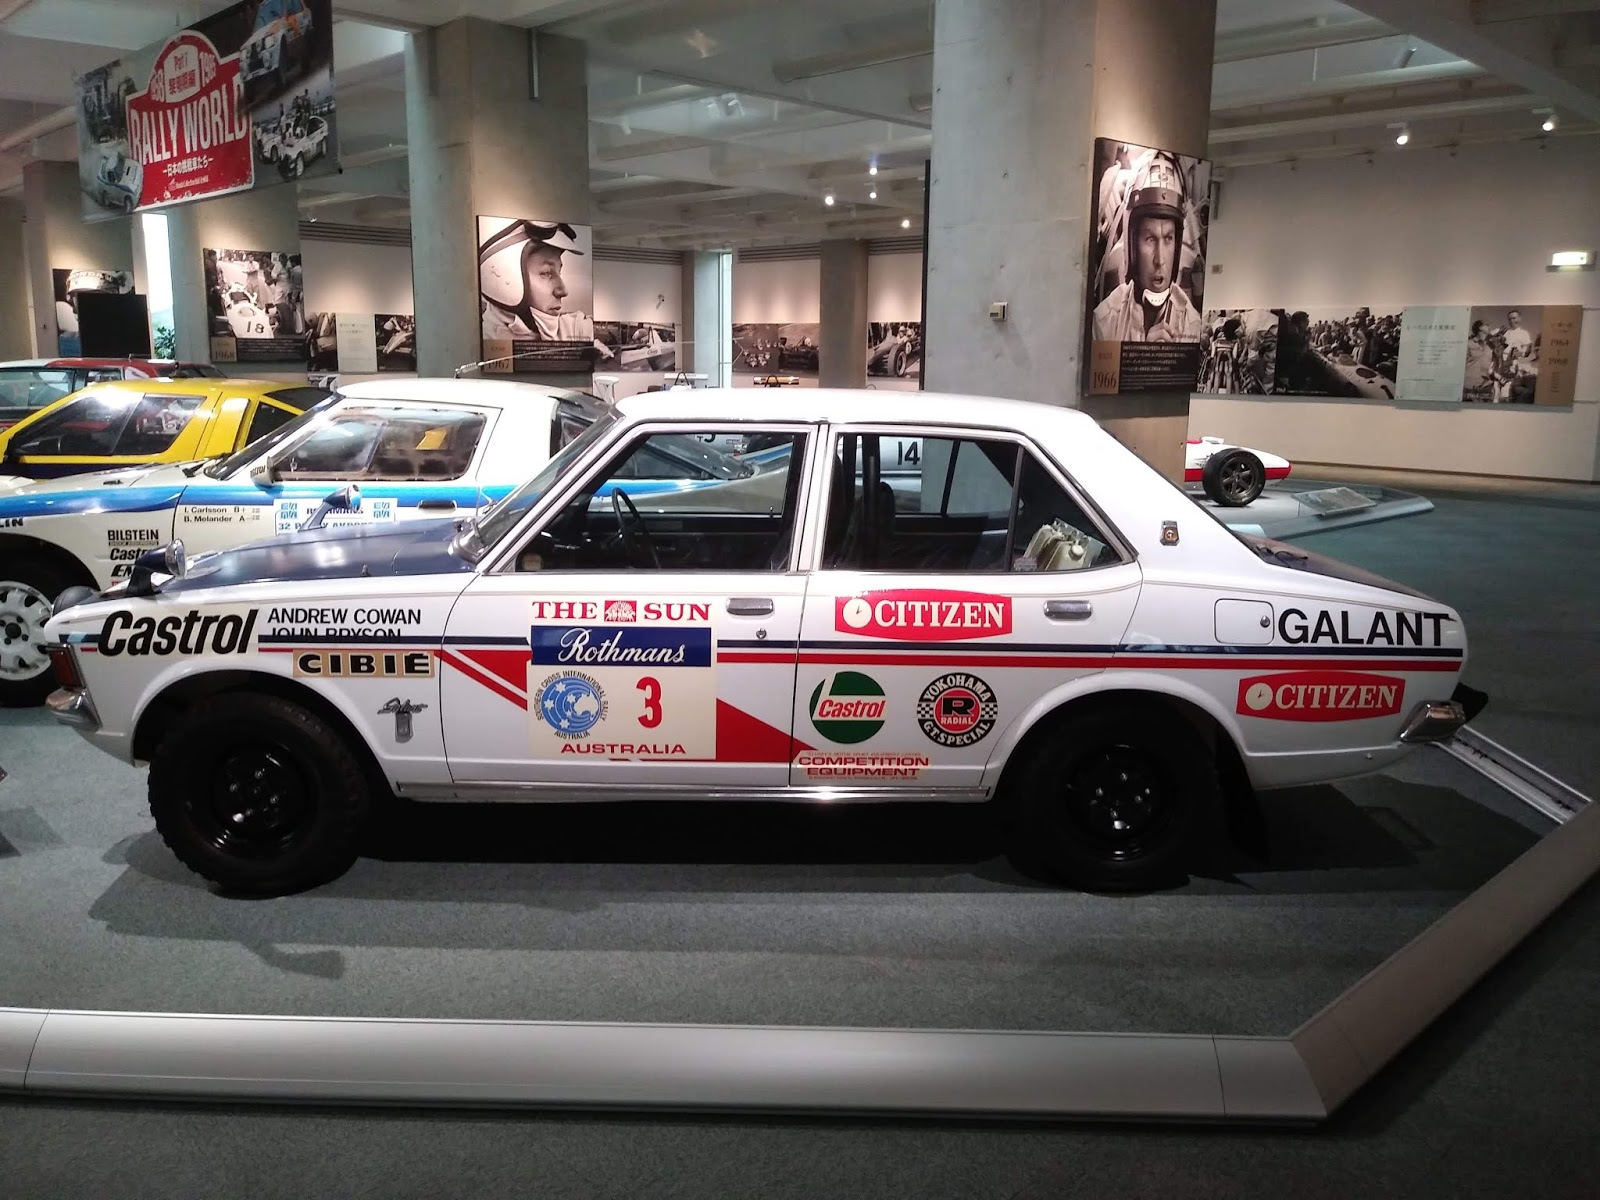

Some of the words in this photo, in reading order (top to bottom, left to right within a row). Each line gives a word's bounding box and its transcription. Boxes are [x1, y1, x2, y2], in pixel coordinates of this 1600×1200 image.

[130, 108, 178, 166] RALLY
[182, 72, 247, 154] WORLD
[1093, 371, 1117, 389] 1966
[897, 441, 921, 465] 14
[191, 506, 227, 514] Carlsson
[194, 515, 232, 523] Melander
[107, 529, 159, 541] BILSTEIN
[267, 608, 348, 624] ANDREW
[353, 608, 421, 625] COWAN
[532, 601, 598, 620] THE
[644, 602, 712, 621] SUN
[874, 599, 1005, 629] CITIZEN
[100, 609, 259, 657] Castrol
[1278, 607, 1450, 647] GALANT
[558, 627, 686, 664] Rothmans
[562, 670, 606, 698] INTERNATIONAL
[923, 674, 992, 702] YOKOHAMA
[636, 676, 663, 729] 3
[941, 696, 976, 716] R
[1275, 684, 1398, 709] CITIZEN
[818, 699, 886, 719] Castrol
[940, 716, 974, 725] RADIAL
[554, 730, 591, 740] AUSTRALIA
[560, 743, 687, 755] AUSTRALIA
[799, 756, 929, 767] COMPETITION
[807, 768, 920, 776] EQUIPMENT
